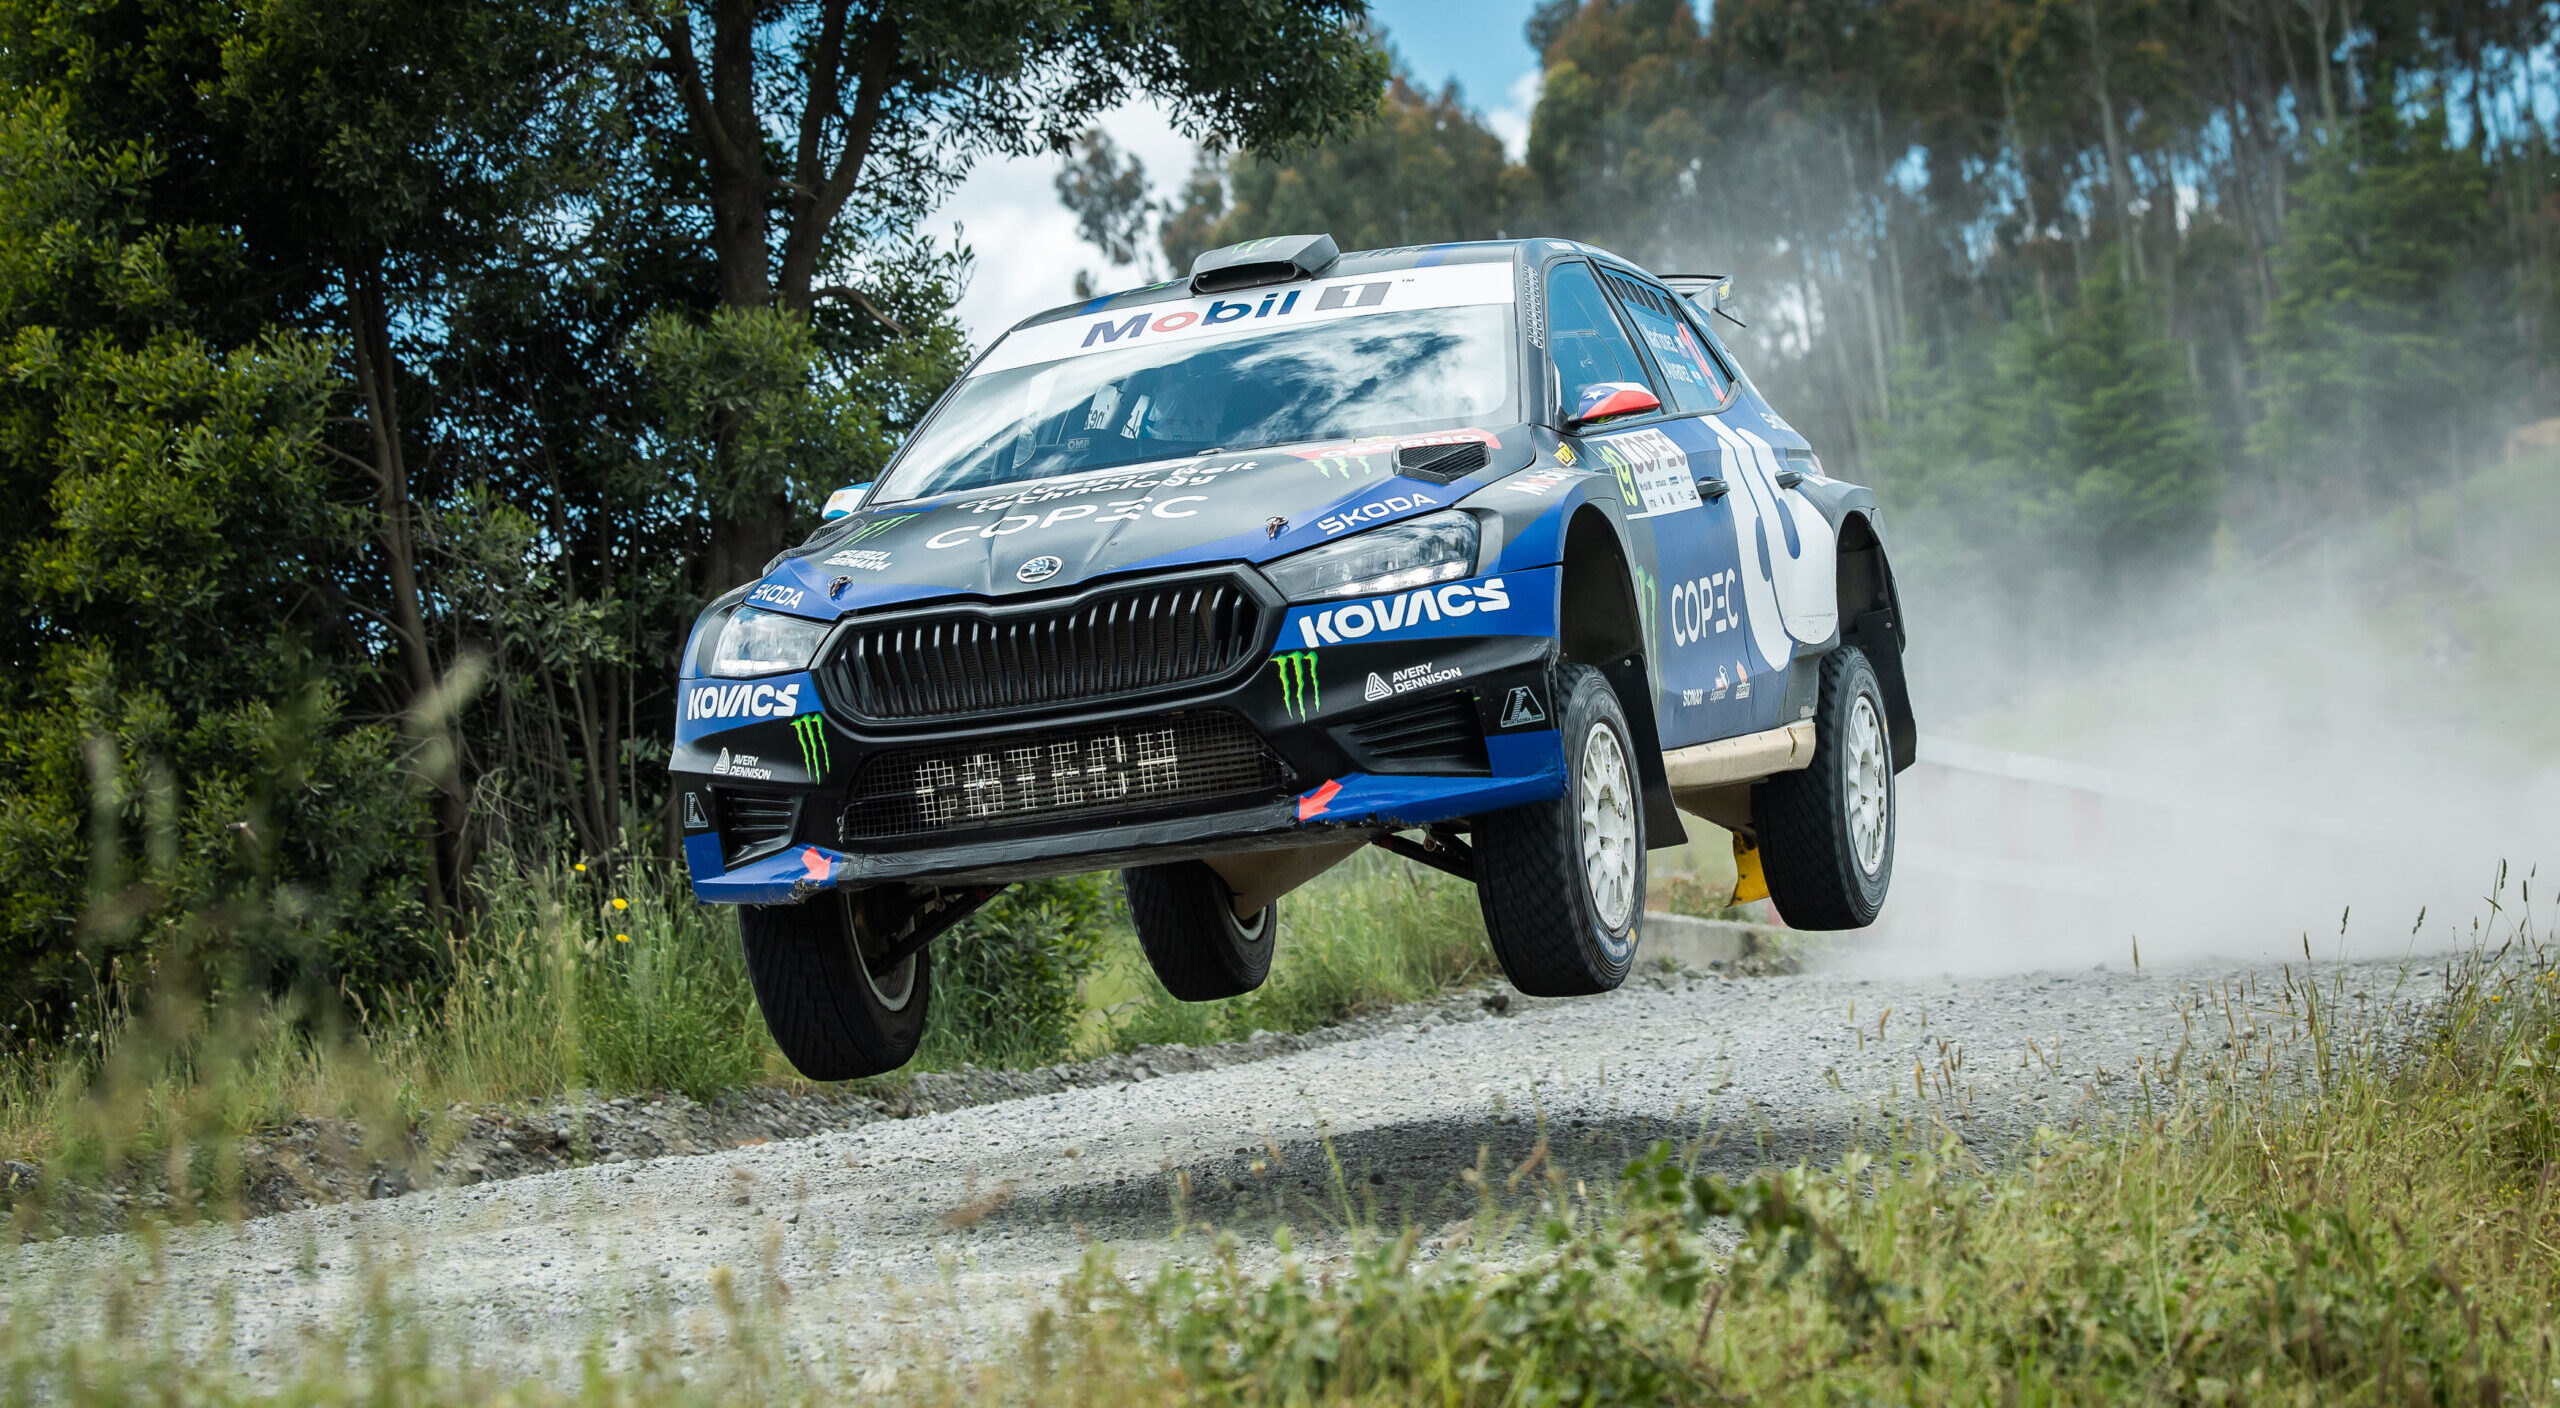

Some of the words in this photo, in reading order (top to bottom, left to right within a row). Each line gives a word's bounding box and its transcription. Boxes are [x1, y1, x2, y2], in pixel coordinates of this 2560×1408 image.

[1081, 290, 1300, 347] Mobil
[1067, 439, 1090, 450] OMP
[925, 495, 1209, 550] COPEC
[1298, 578, 1510, 649] KOVACS
[1671, 568, 1739, 648] COPEC
[1392, 662, 1433, 683] AVERY
[1394, 666, 1462, 694] DENNISON
[687, 683, 800, 720] KOVACS
[729, 765, 771, 781] DENNISON
[732, 754, 759, 767] AVERY
